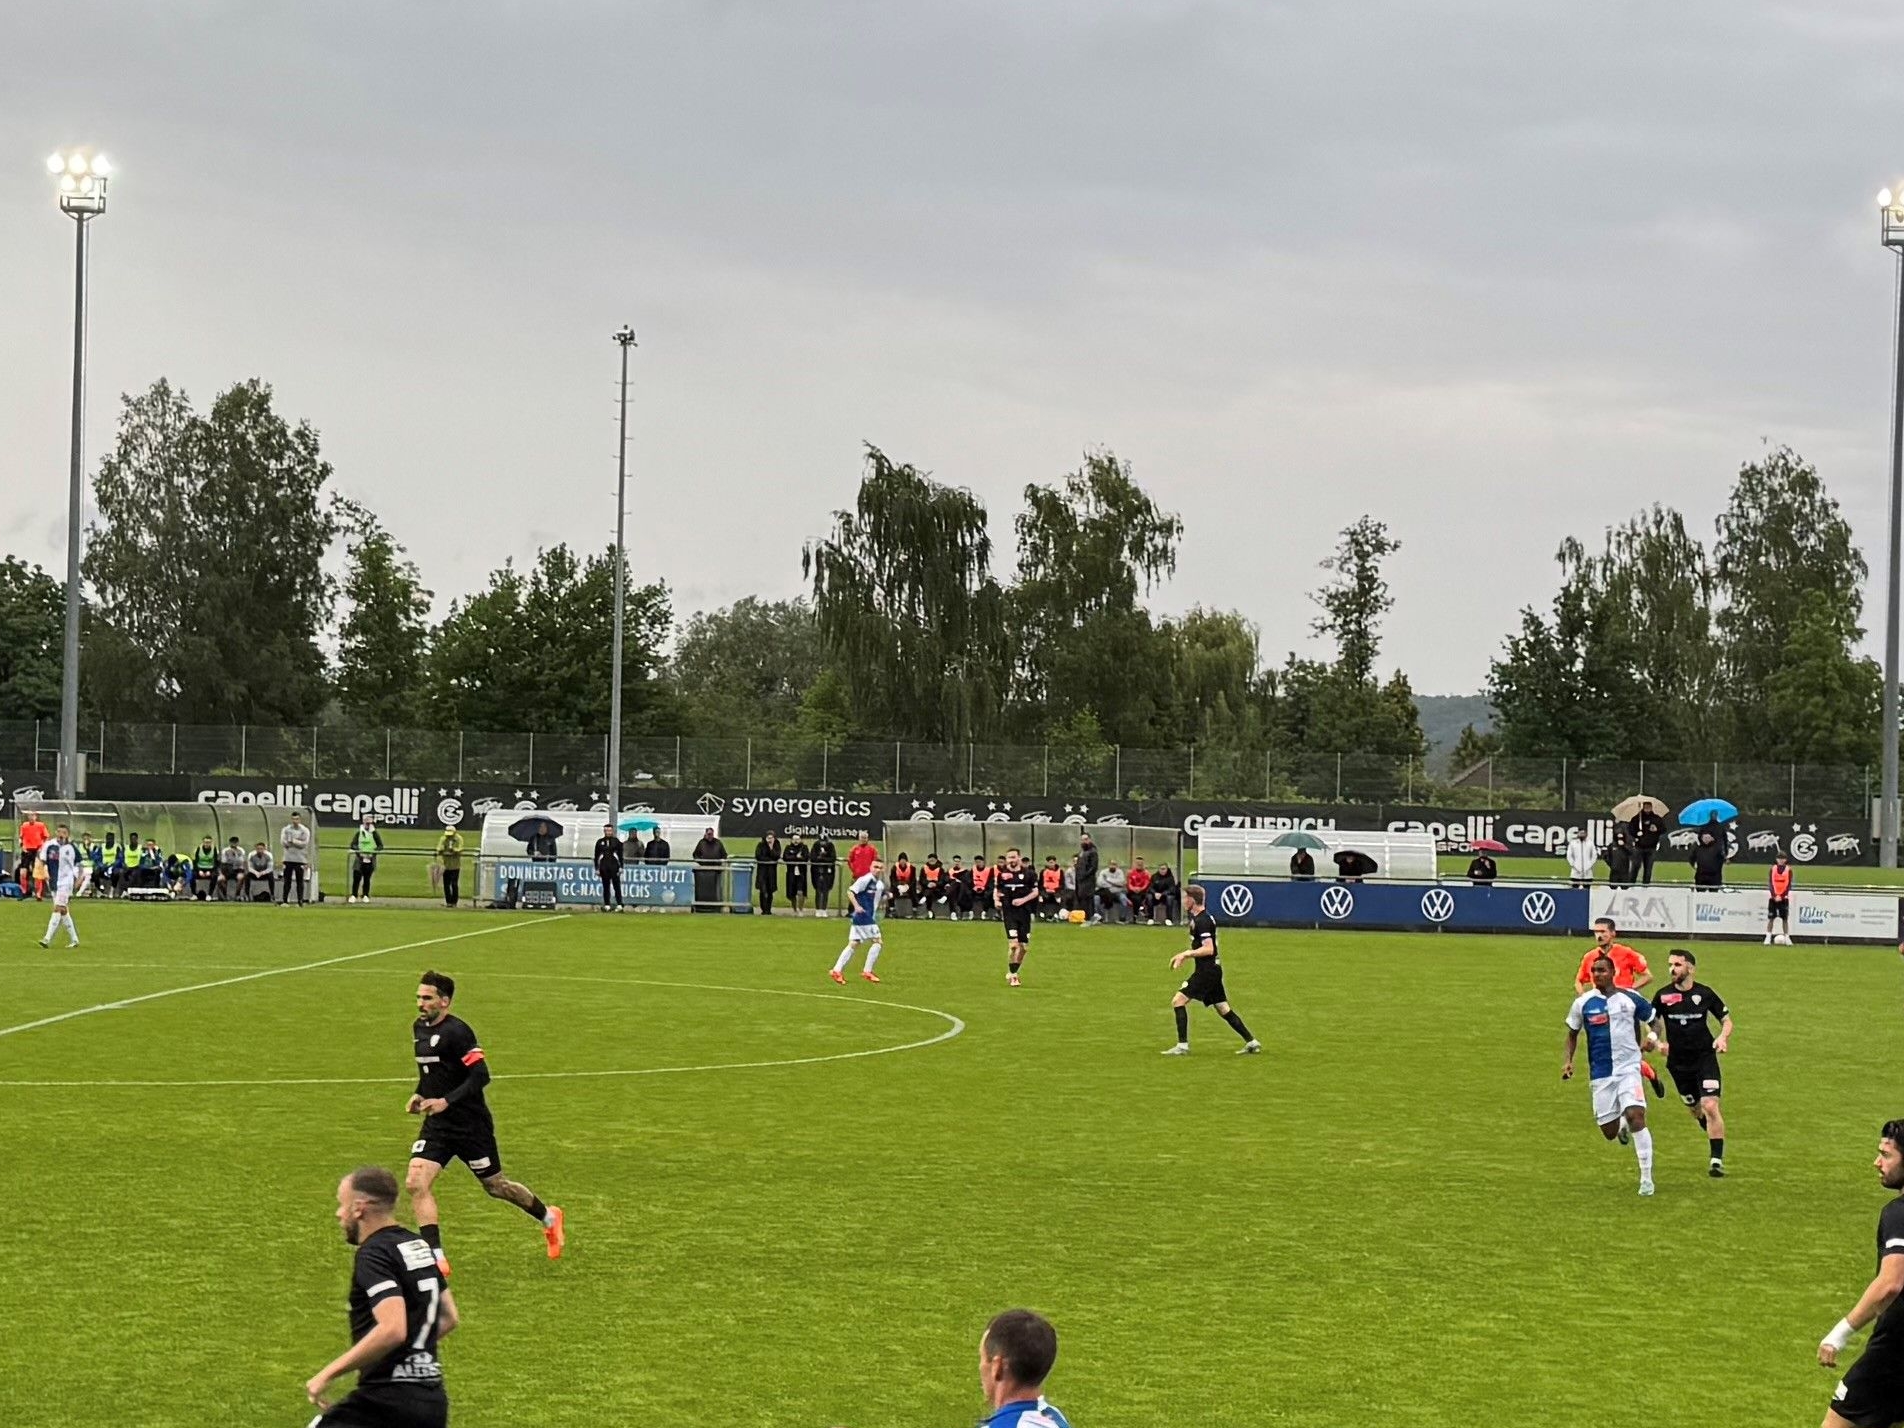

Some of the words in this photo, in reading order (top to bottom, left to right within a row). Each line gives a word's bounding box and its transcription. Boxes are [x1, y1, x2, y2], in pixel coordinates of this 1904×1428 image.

[314, 787, 419, 820] capelli
[731, 796, 871, 818] synergetics
[784, 824, 819, 837] digital
[500, 865, 574, 880] DONNERSTAG
[620, 867, 687, 883] NTERSTÜTZT
[562, 883, 650, 898] GC-NACUCHS
